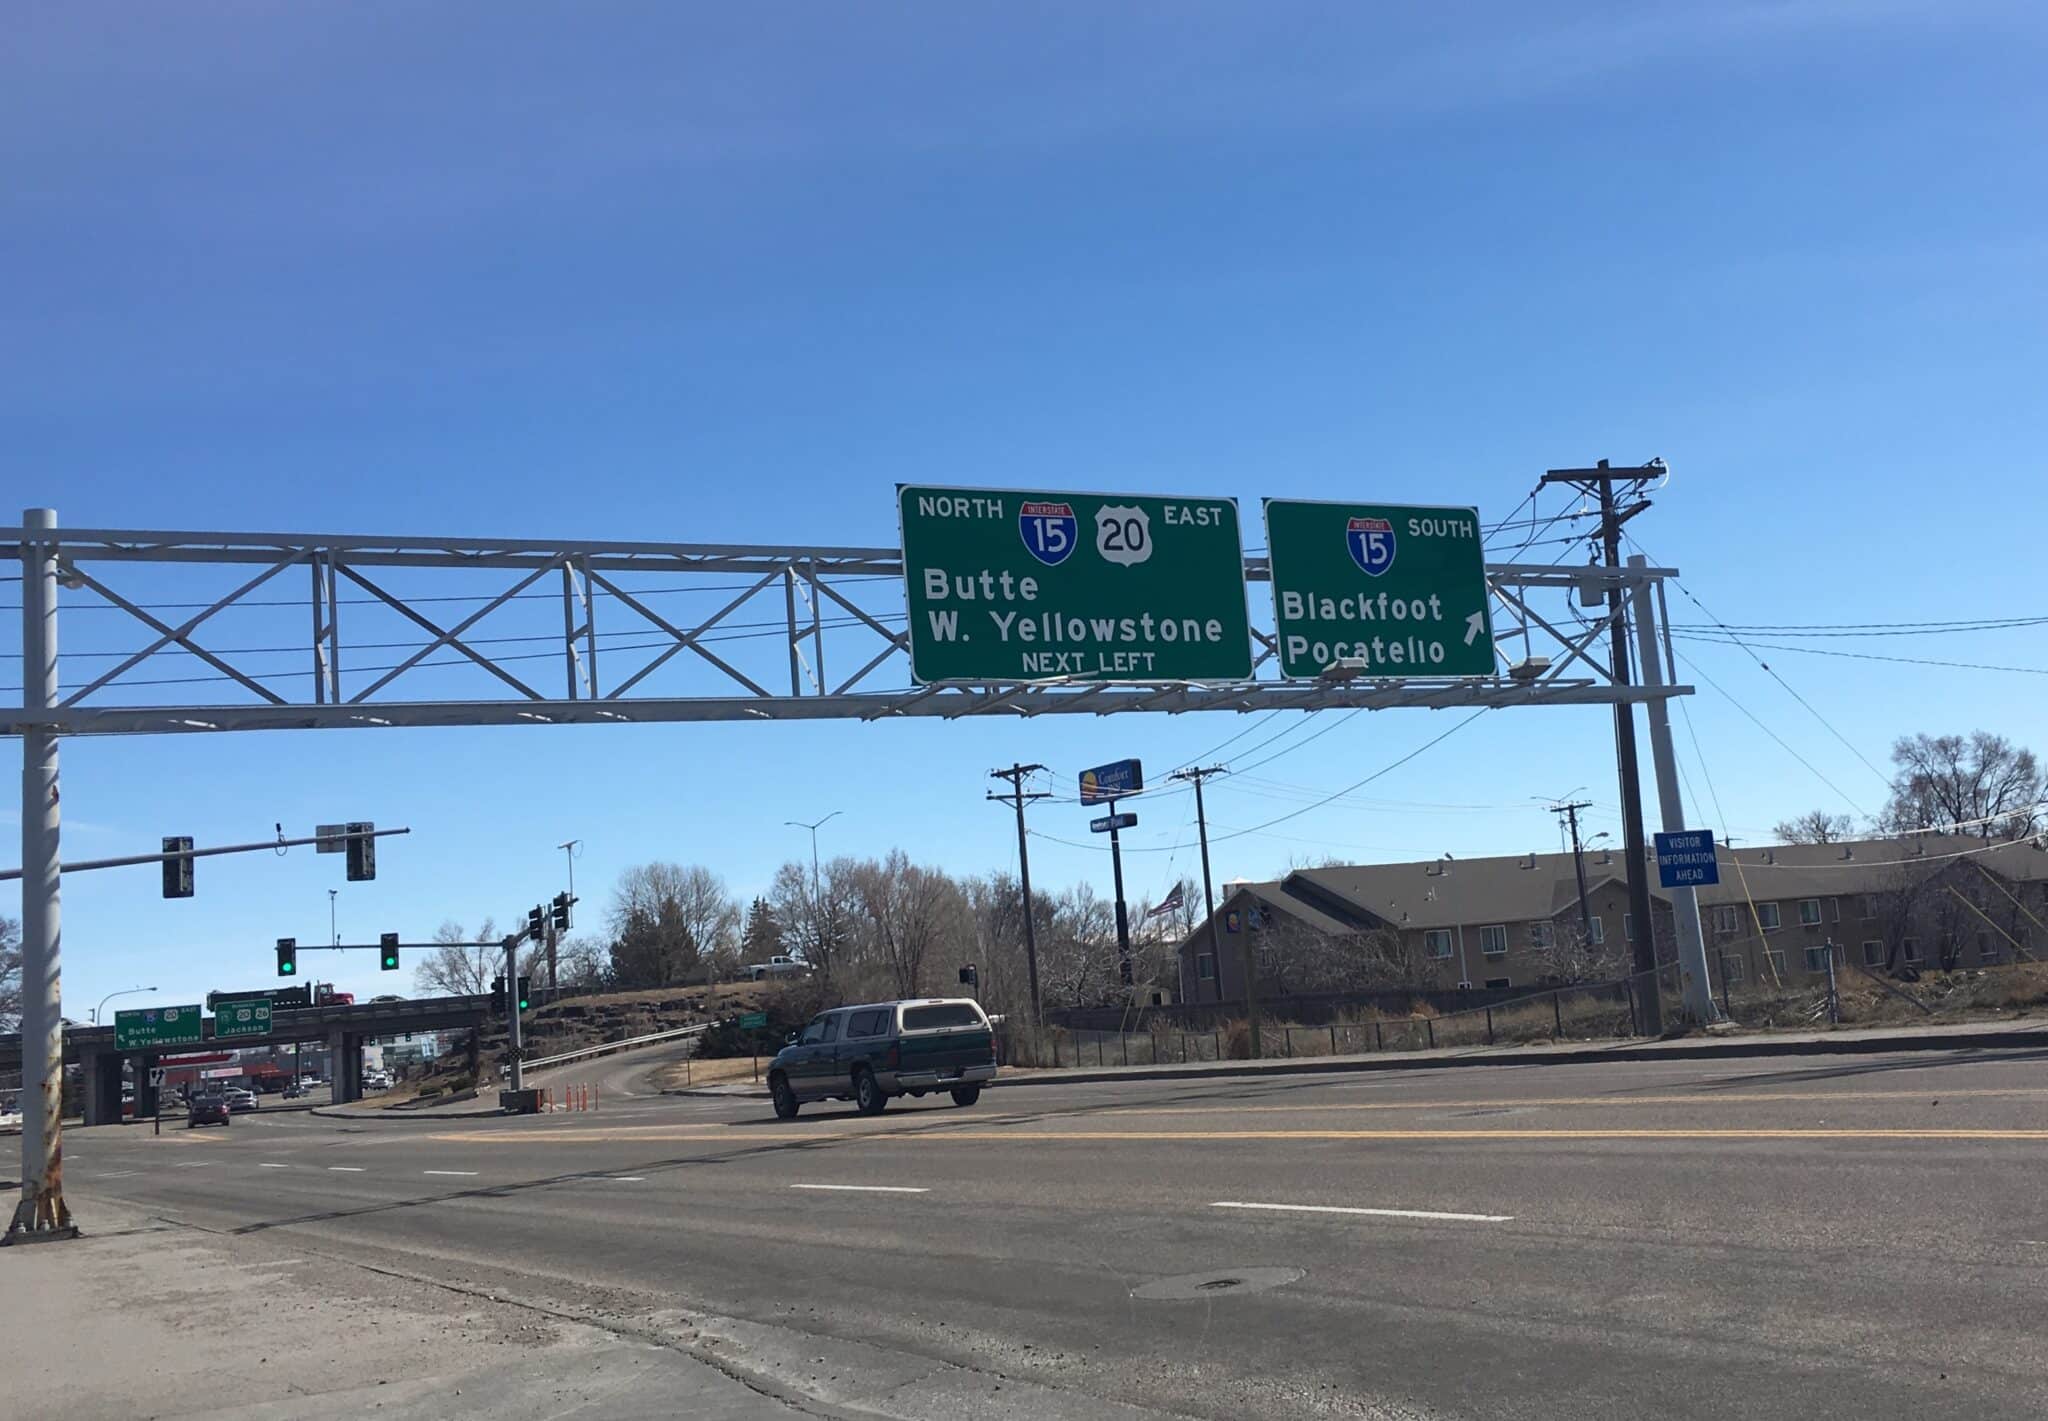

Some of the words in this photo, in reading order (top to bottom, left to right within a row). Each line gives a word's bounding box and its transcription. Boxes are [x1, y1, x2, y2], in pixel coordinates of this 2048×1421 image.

[918, 496, 1004, 519] NORTH
[1027, 504, 1066, 514] INTERSTATE
[1163, 505, 1222, 526] EAST
[1033, 518, 1067, 552] 15
[1101, 518, 1145, 551] 20
[1408, 518, 1473, 538] SOUTH
[1359, 532, 1388, 564] 15
[923, 568, 1039, 600] Butte
[1282, 591, 1443, 621] Blackfoot
[927, 610, 970, 642] W.
[988, 611, 1224, 642] Yellowstone
[1287, 635, 1445, 664] Pocatello
[1022, 652, 1085, 673] NEXT
[1098, 652, 1156, 673] LEFT
[1669, 837, 1701, 848] VISITOR
[1660, 852, 1714, 864] INFORMATION
[1676, 868, 1703, 880] AHEAD
[128, 1027, 156, 1036] Butte
[224, 1024, 264, 1035] Jackson
